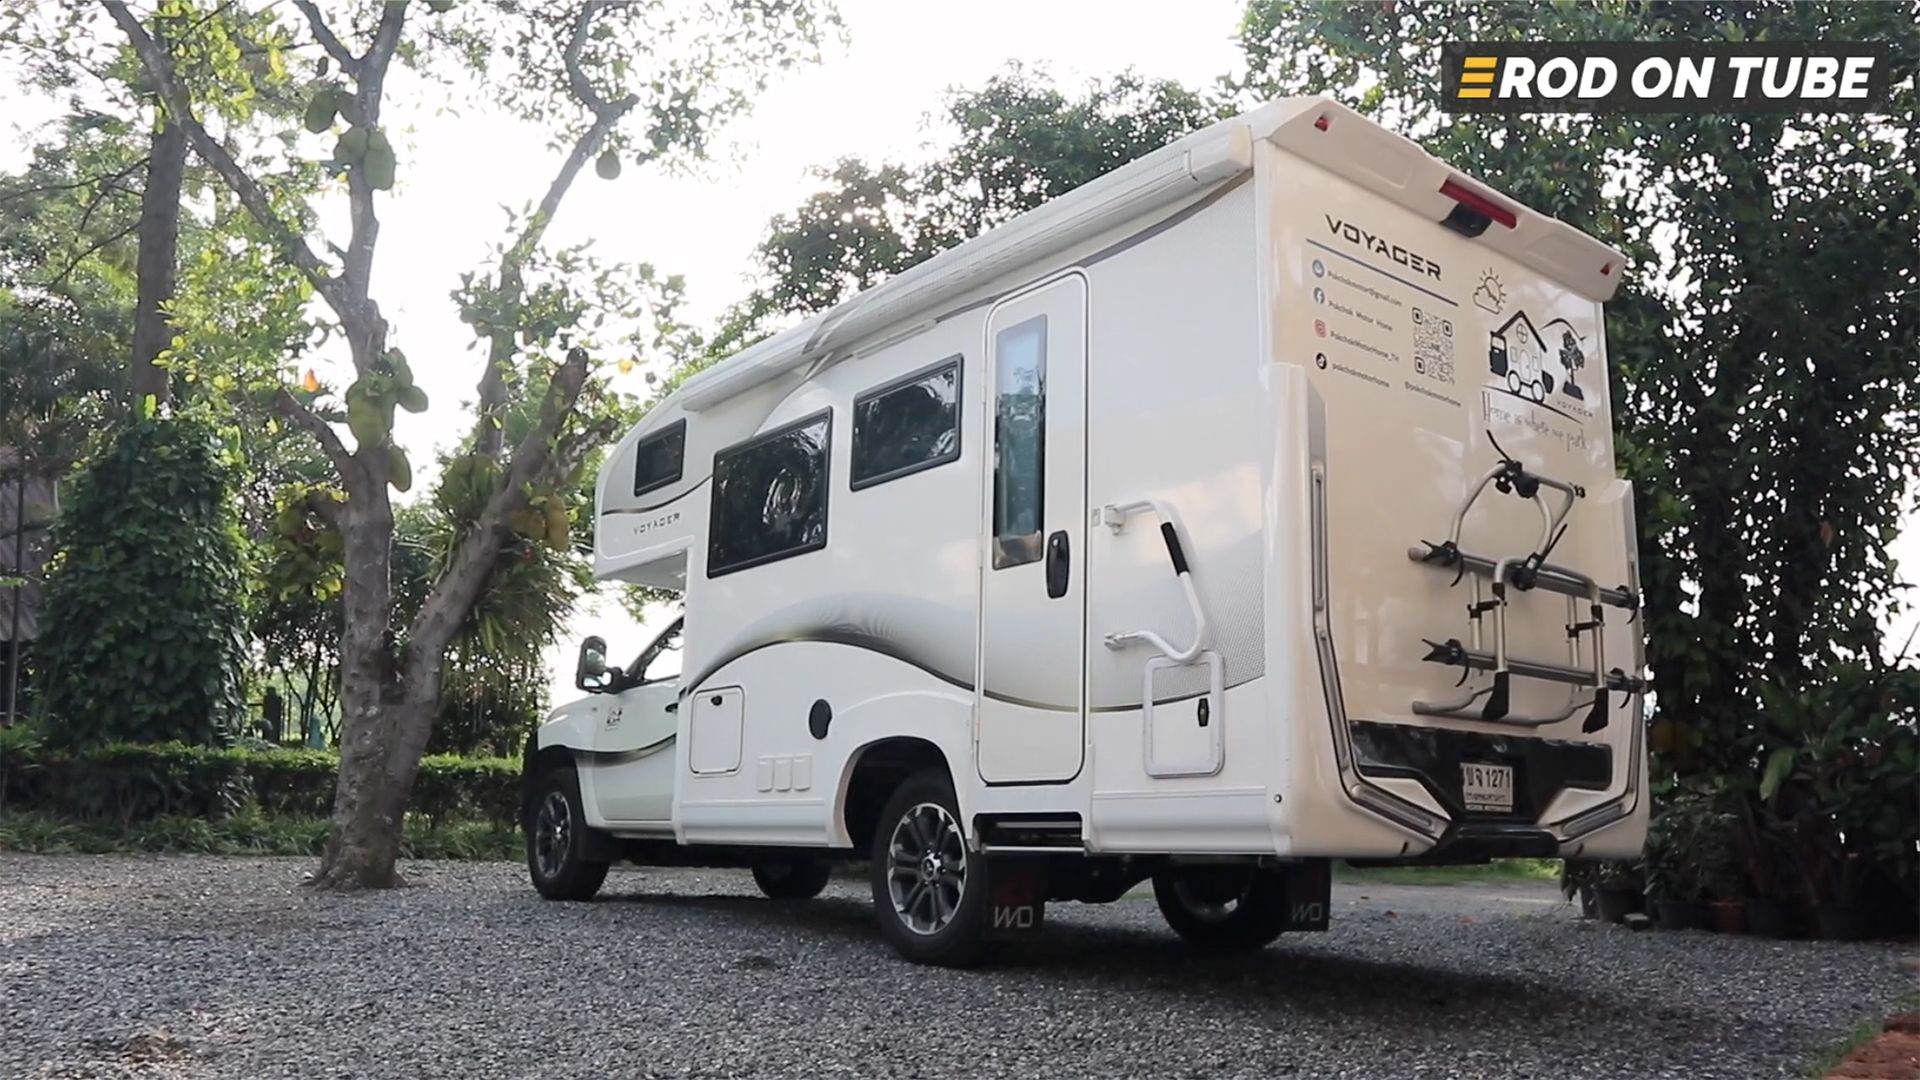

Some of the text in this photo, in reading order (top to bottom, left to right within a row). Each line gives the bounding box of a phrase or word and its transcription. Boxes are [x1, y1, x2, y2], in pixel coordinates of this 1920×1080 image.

[1325, 214, 1441, 281] VOYAGER
[633, 512, 680, 535] VOYAGER
[1486, 769, 1511, 788] 1271
